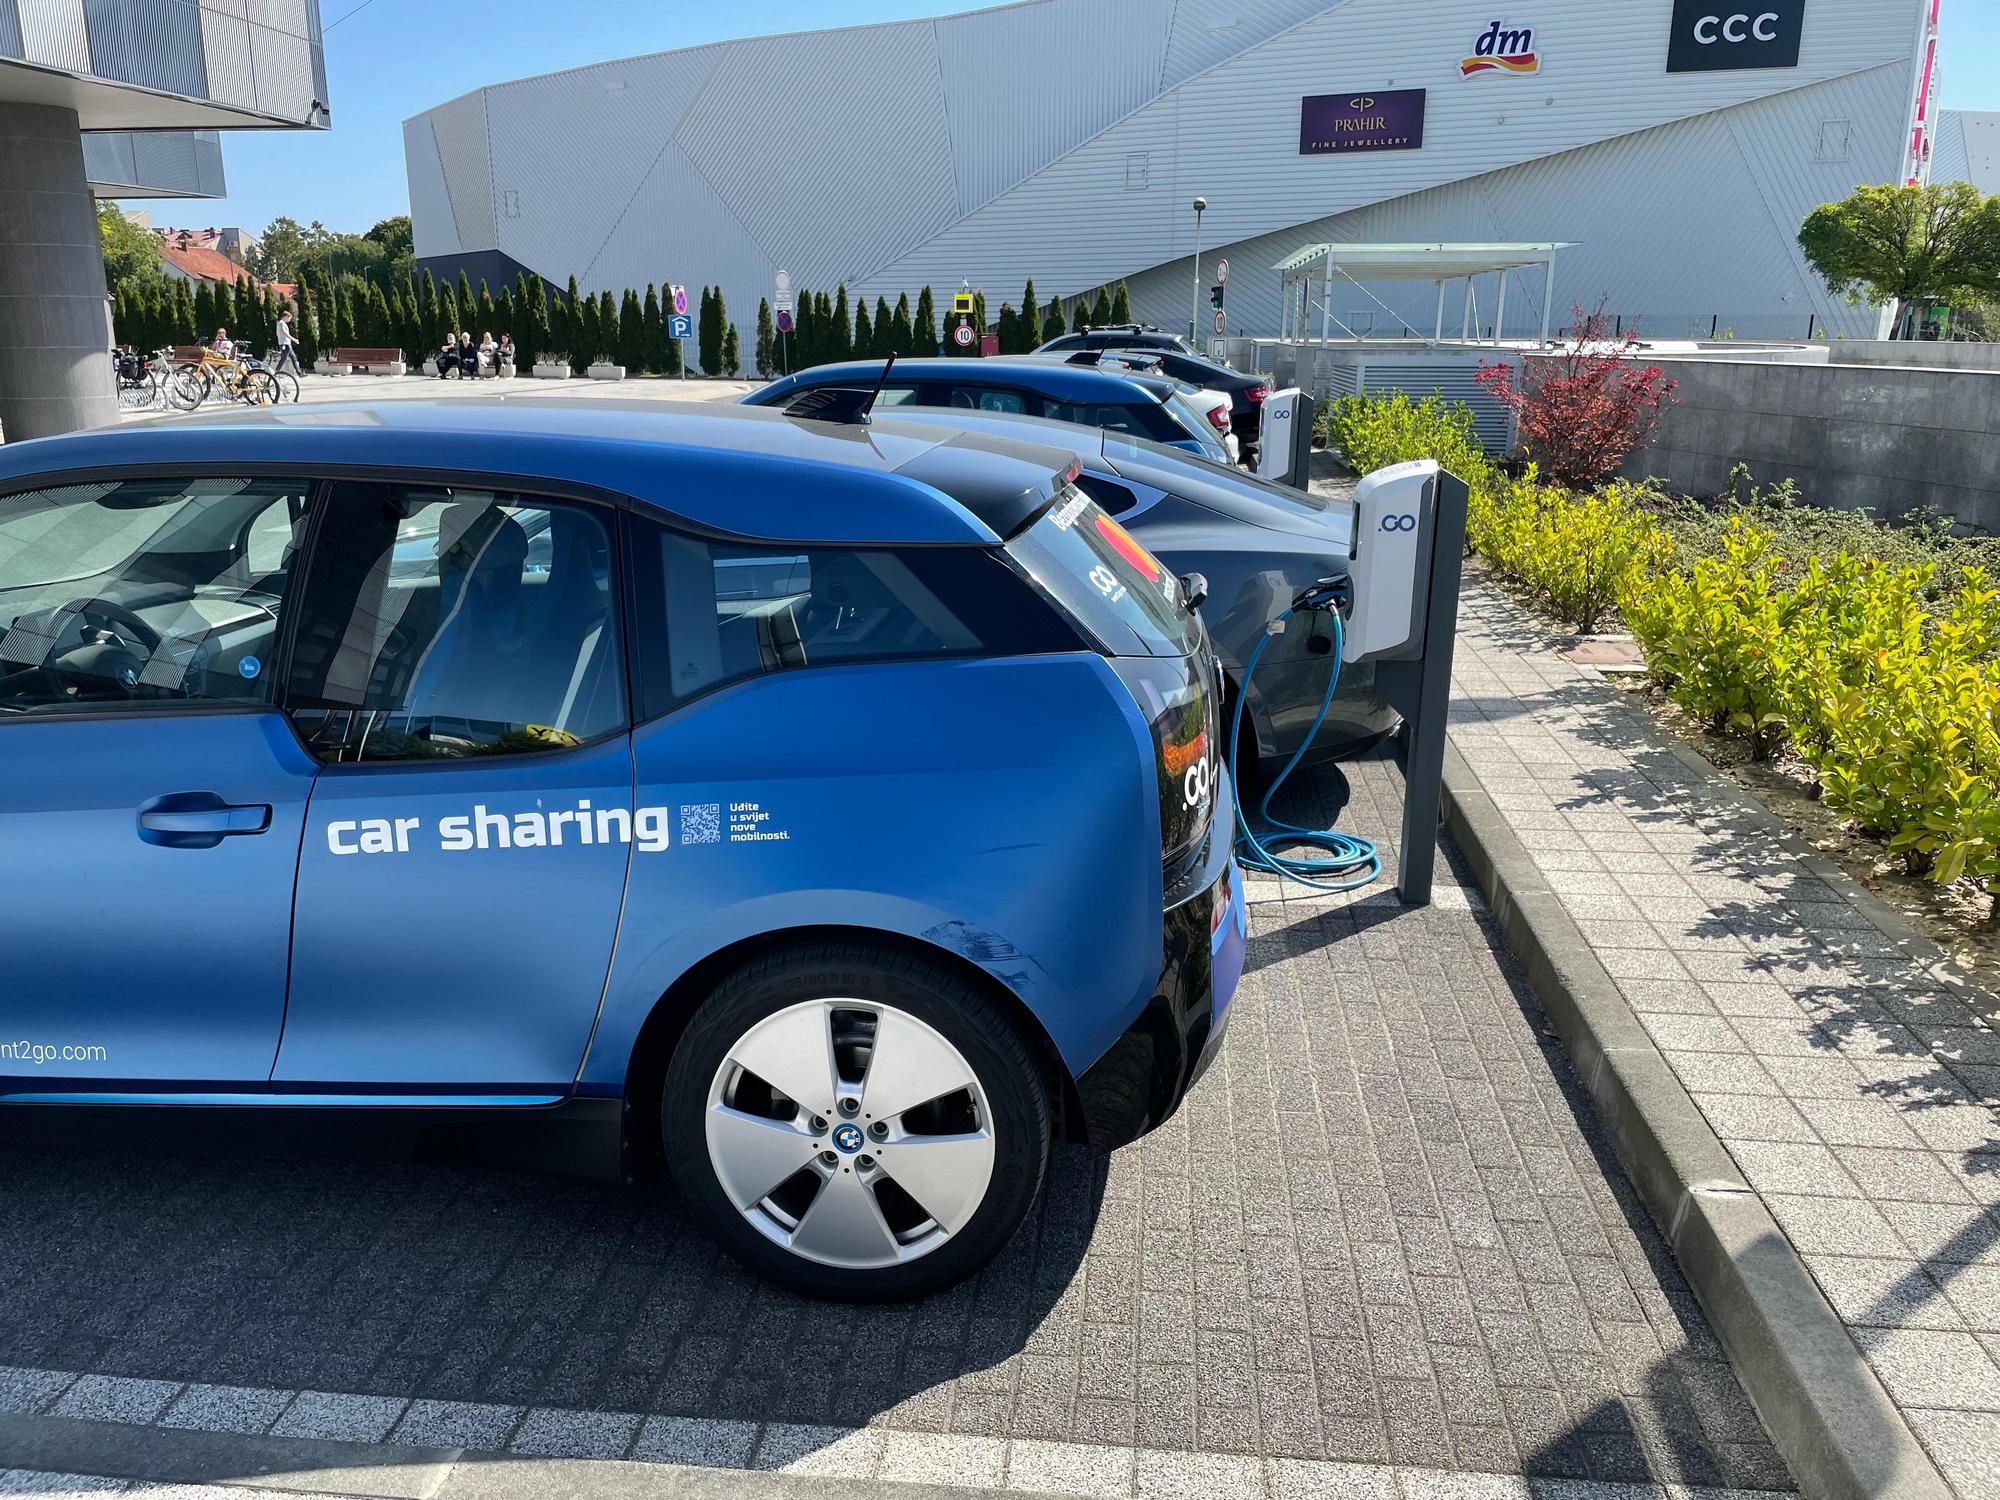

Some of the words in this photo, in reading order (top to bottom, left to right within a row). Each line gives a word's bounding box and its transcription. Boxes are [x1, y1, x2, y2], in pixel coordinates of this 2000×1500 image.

[1694, 12, 1779, 45] CCC
[1475, 20, 1532, 56] dm
[1335, 117, 1387, 132] PRAHIR
[1344, 137, 1408, 147] JEWELLERY
[675, 321, 686, 336] P
[960, 330, 970, 341] 10
[740, 812, 769, 822] svijet
[326, 817, 420, 855] car
[439, 799, 670, 852] sharing
[730, 823, 756, 831] nove
[731, 831, 790, 841] mobilnosti.
